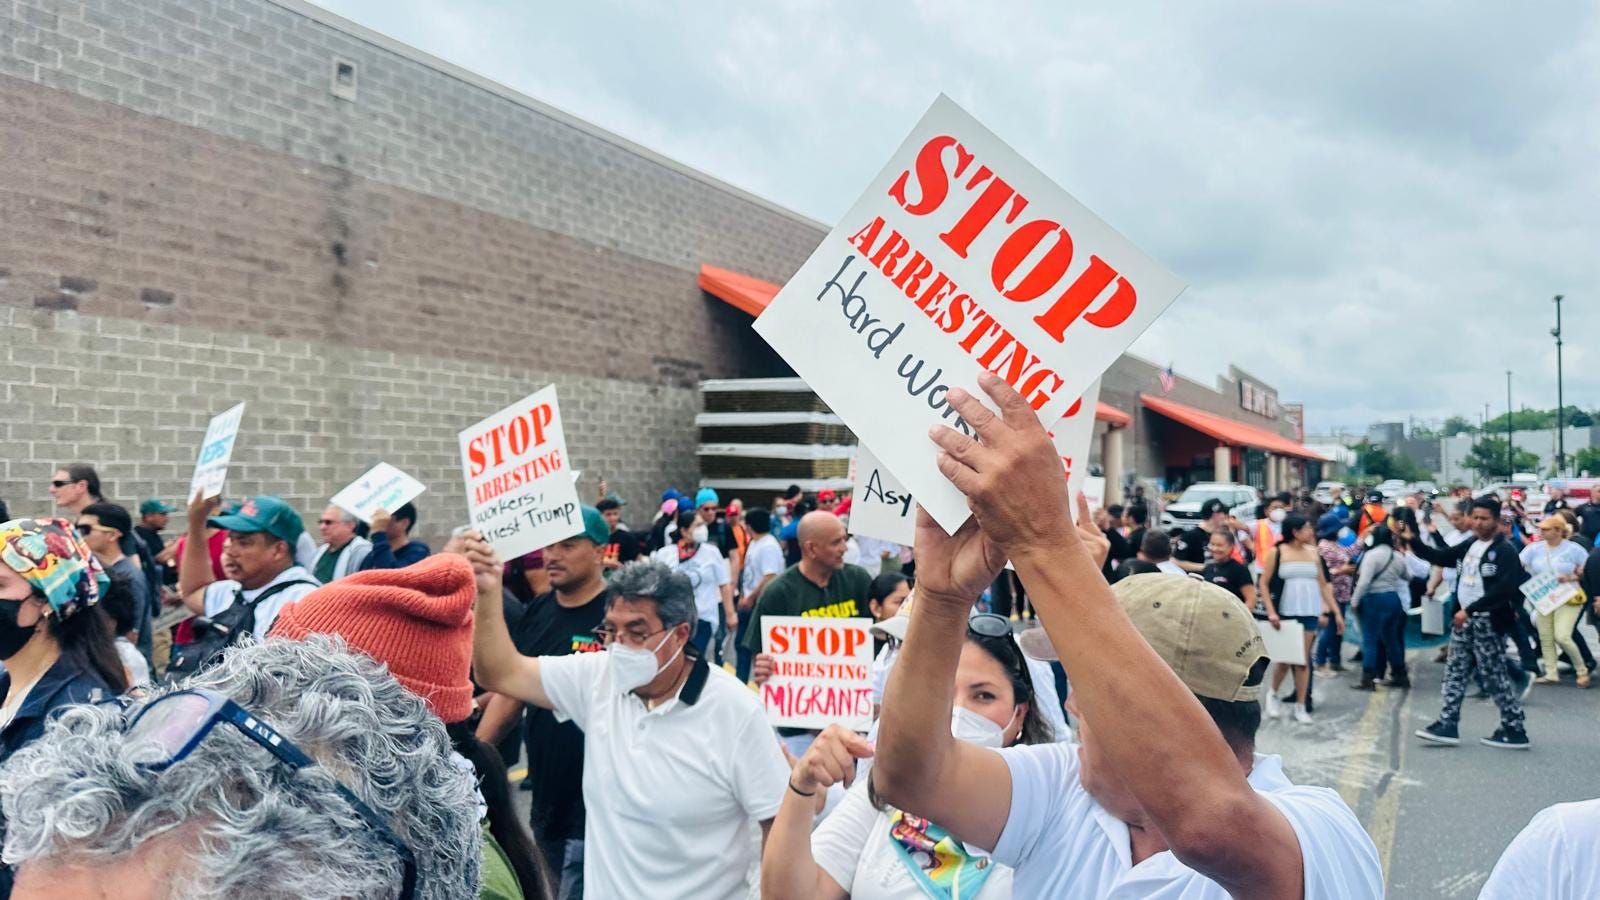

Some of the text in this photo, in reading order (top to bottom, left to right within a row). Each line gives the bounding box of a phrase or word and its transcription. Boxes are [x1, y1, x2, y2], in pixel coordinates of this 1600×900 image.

[888, 136, 1137, 343] STOP
[816, 255, 905, 359] Hard
[848, 216, 1065, 411] ARRESTING
[468, 404, 553, 478] STOP
[475, 450, 562, 505] ARRESTING
[863, 468, 913, 517] Asy
[522, 502, 575, 526] Trump
[769, 625, 866, 657] STOP
[773, 661, 868, 680] ARRESTING
